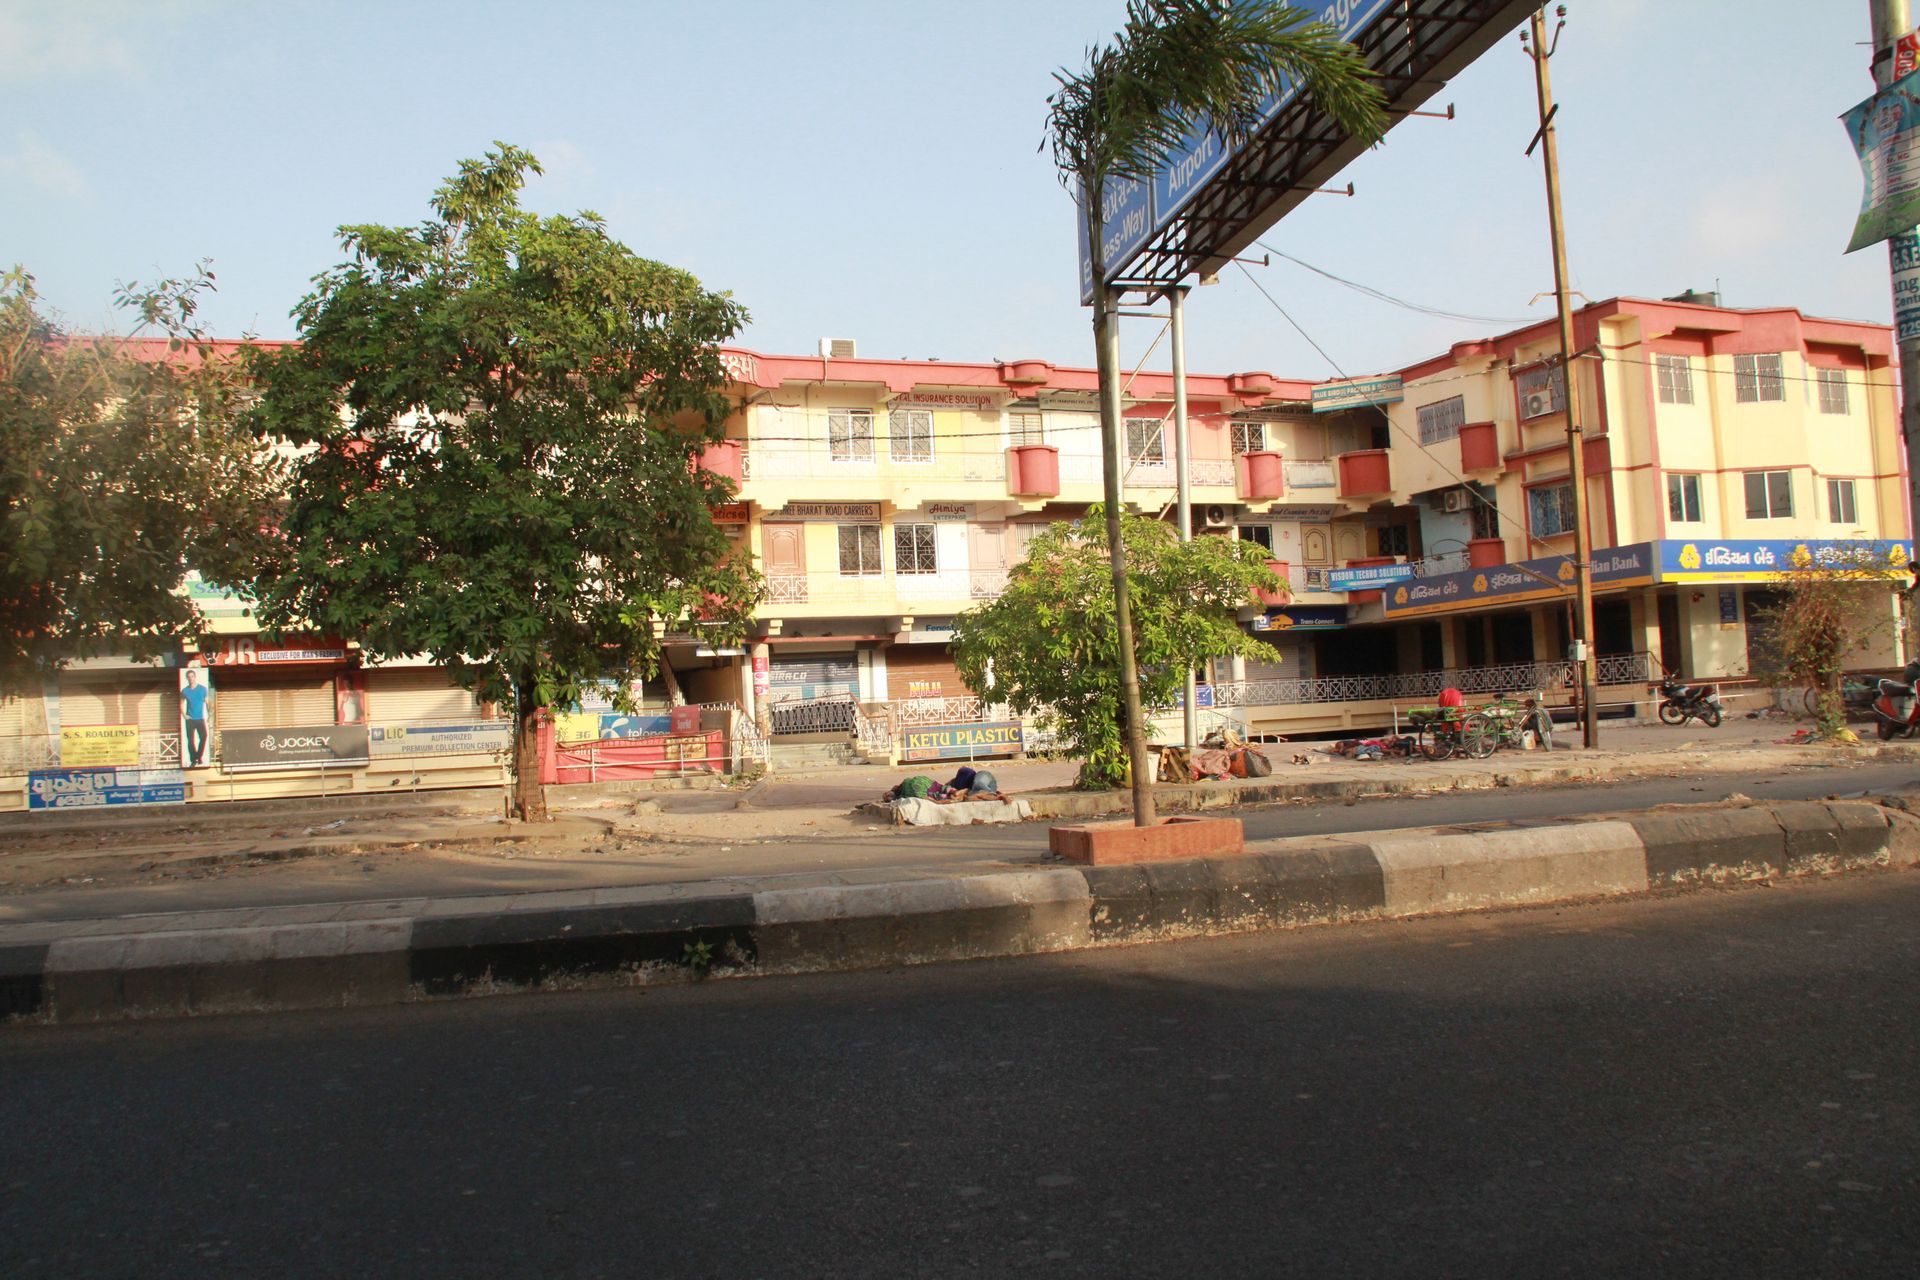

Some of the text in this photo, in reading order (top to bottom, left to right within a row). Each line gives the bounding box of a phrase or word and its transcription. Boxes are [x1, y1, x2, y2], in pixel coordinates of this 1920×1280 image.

[1168, 135, 1212, 197] Airport
[1083, 205, 1145, 285] Eess-Way
[913, 393, 953, 404] INSURANCE
[954, 394, 991, 405] SOLUTION
[797, 505, 824, 516] BHARAT
[825, 505, 843, 516] ROAD
[844, 505, 873, 516] CARRIERS
[1591, 554, 1641, 574] dian Bank
[1379, 566, 1411, 578] SOLUTIONS
[925, 623, 955, 632] Fenest
[224, 638, 256, 665] JR
[259, 650, 289, 660] EXCLUSIVE
[289, 650, 302, 659] FOR
[85, 729, 136, 739] ROADLINES
[386, 728, 404, 740] LIC
[431, 733, 473, 742] AUTHORIZED
[908, 727, 1020, 748] KETU PLASTIC
[278, 736, 331, 748] JOCKEY
[402, 741, 502, 753] PREMIUM COLLECTION CENTER
